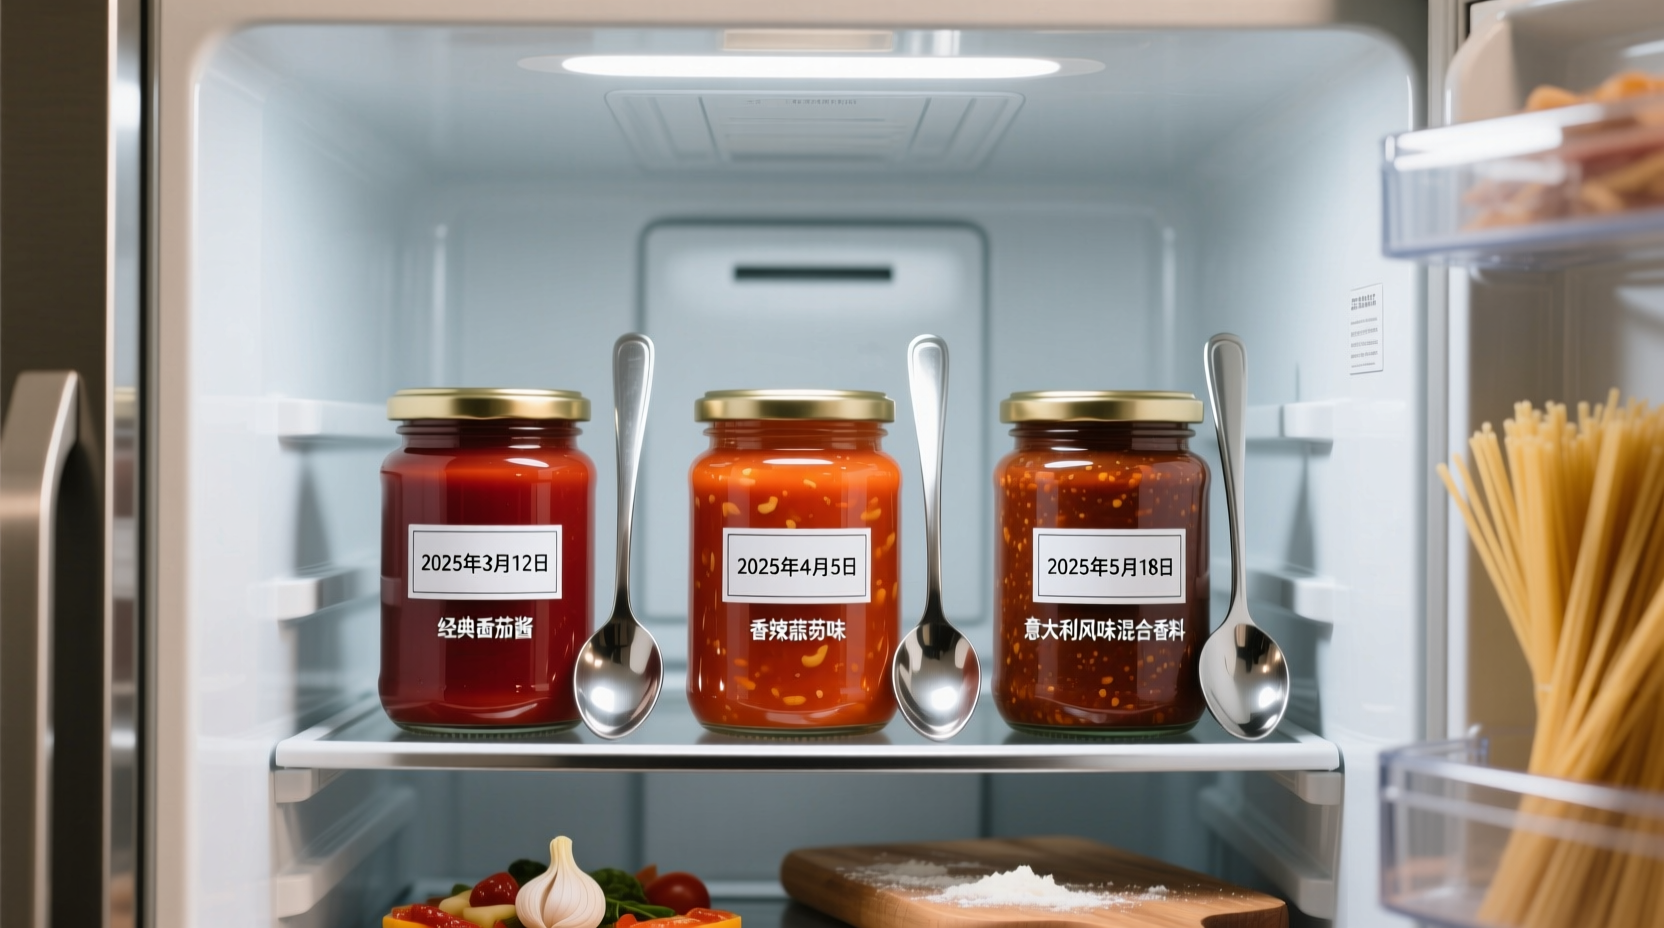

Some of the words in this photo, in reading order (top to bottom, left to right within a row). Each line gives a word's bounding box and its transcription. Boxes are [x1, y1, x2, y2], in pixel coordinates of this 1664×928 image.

[421, 552, 548, 574] 2025年3月12日
[737, 556, 856, 577] 2025年4月5日
[1047, 556, 1173, 577] 2025年5月18日
[1024, 616, 1185, 642] 意大利风味混合香料
